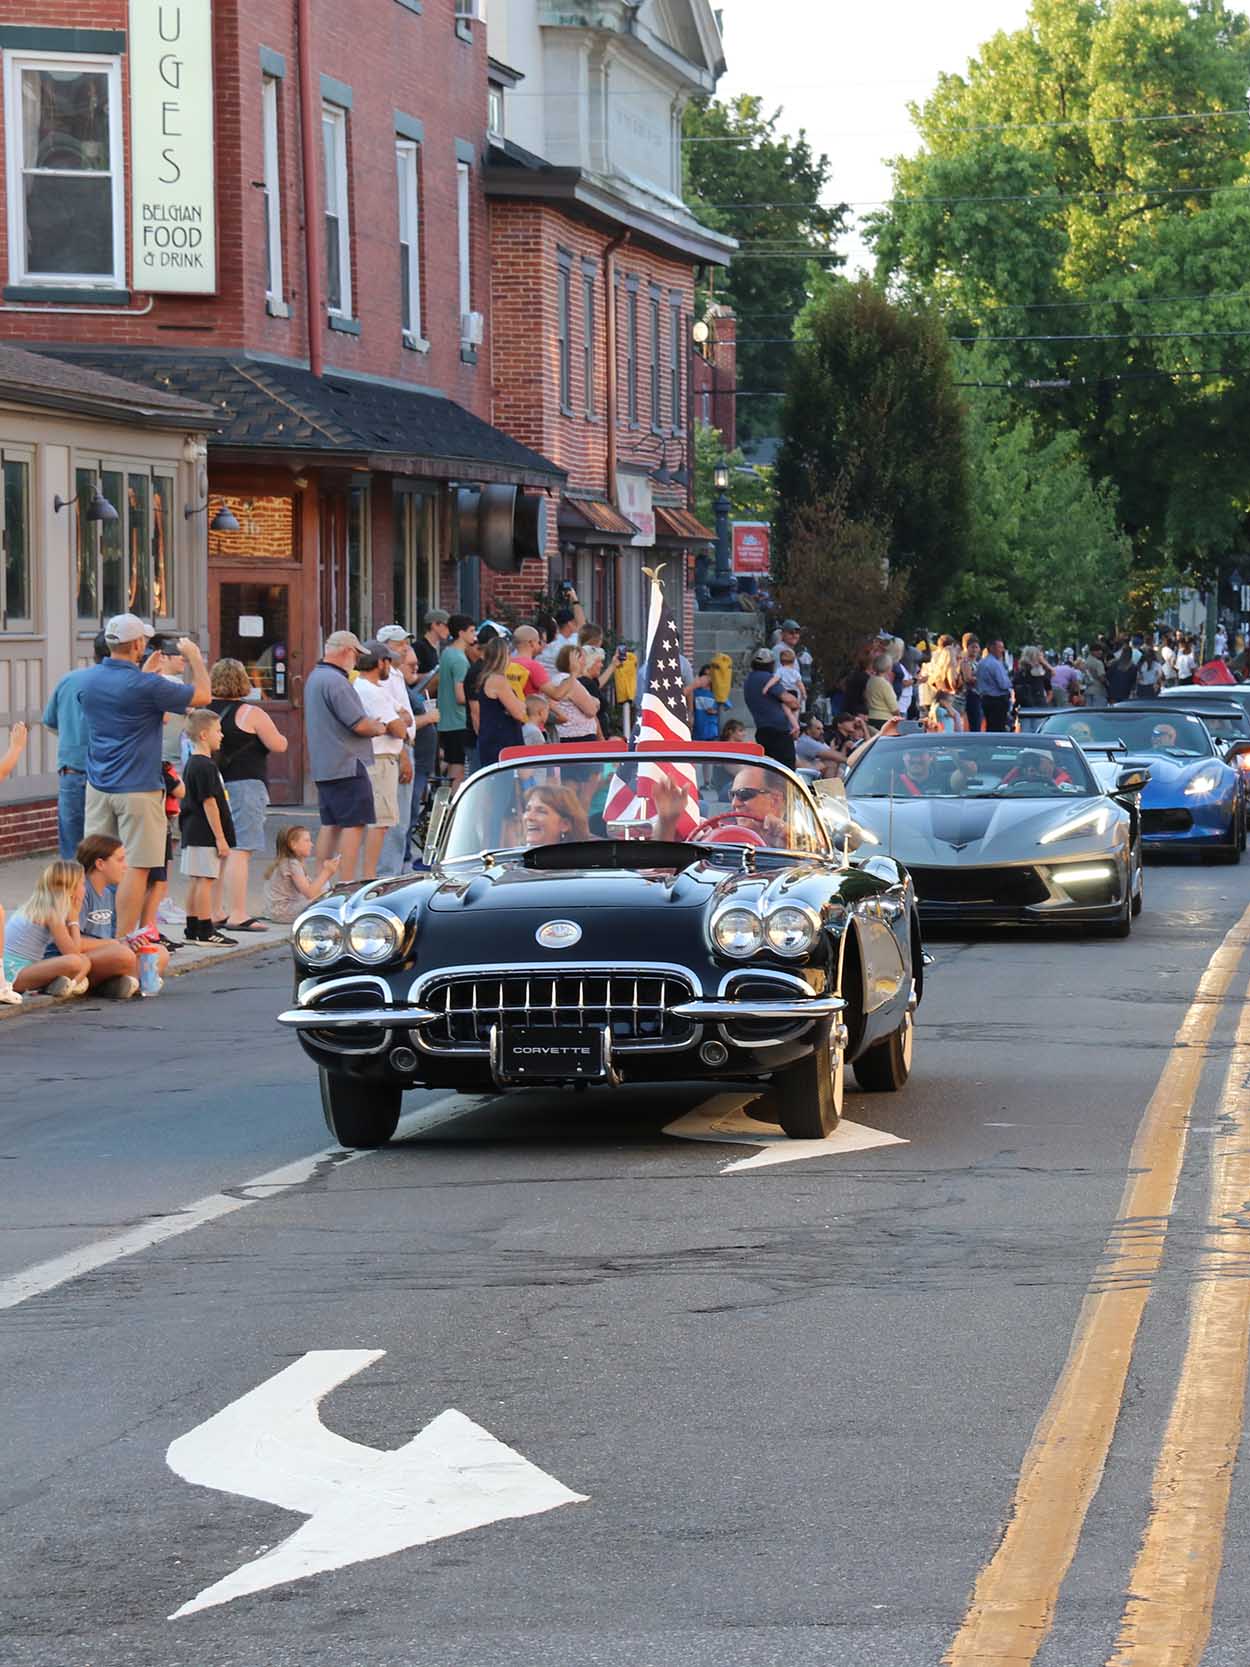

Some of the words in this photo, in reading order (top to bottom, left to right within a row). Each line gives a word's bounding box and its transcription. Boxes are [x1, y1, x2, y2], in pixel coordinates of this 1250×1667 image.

[142, 203, 202, 222] BELGIAN
[143, 225, 202, 248] FOOD
[160, 251, 204, 269] DRINK
[512, 1046, 591, 1055] CORVETTE
